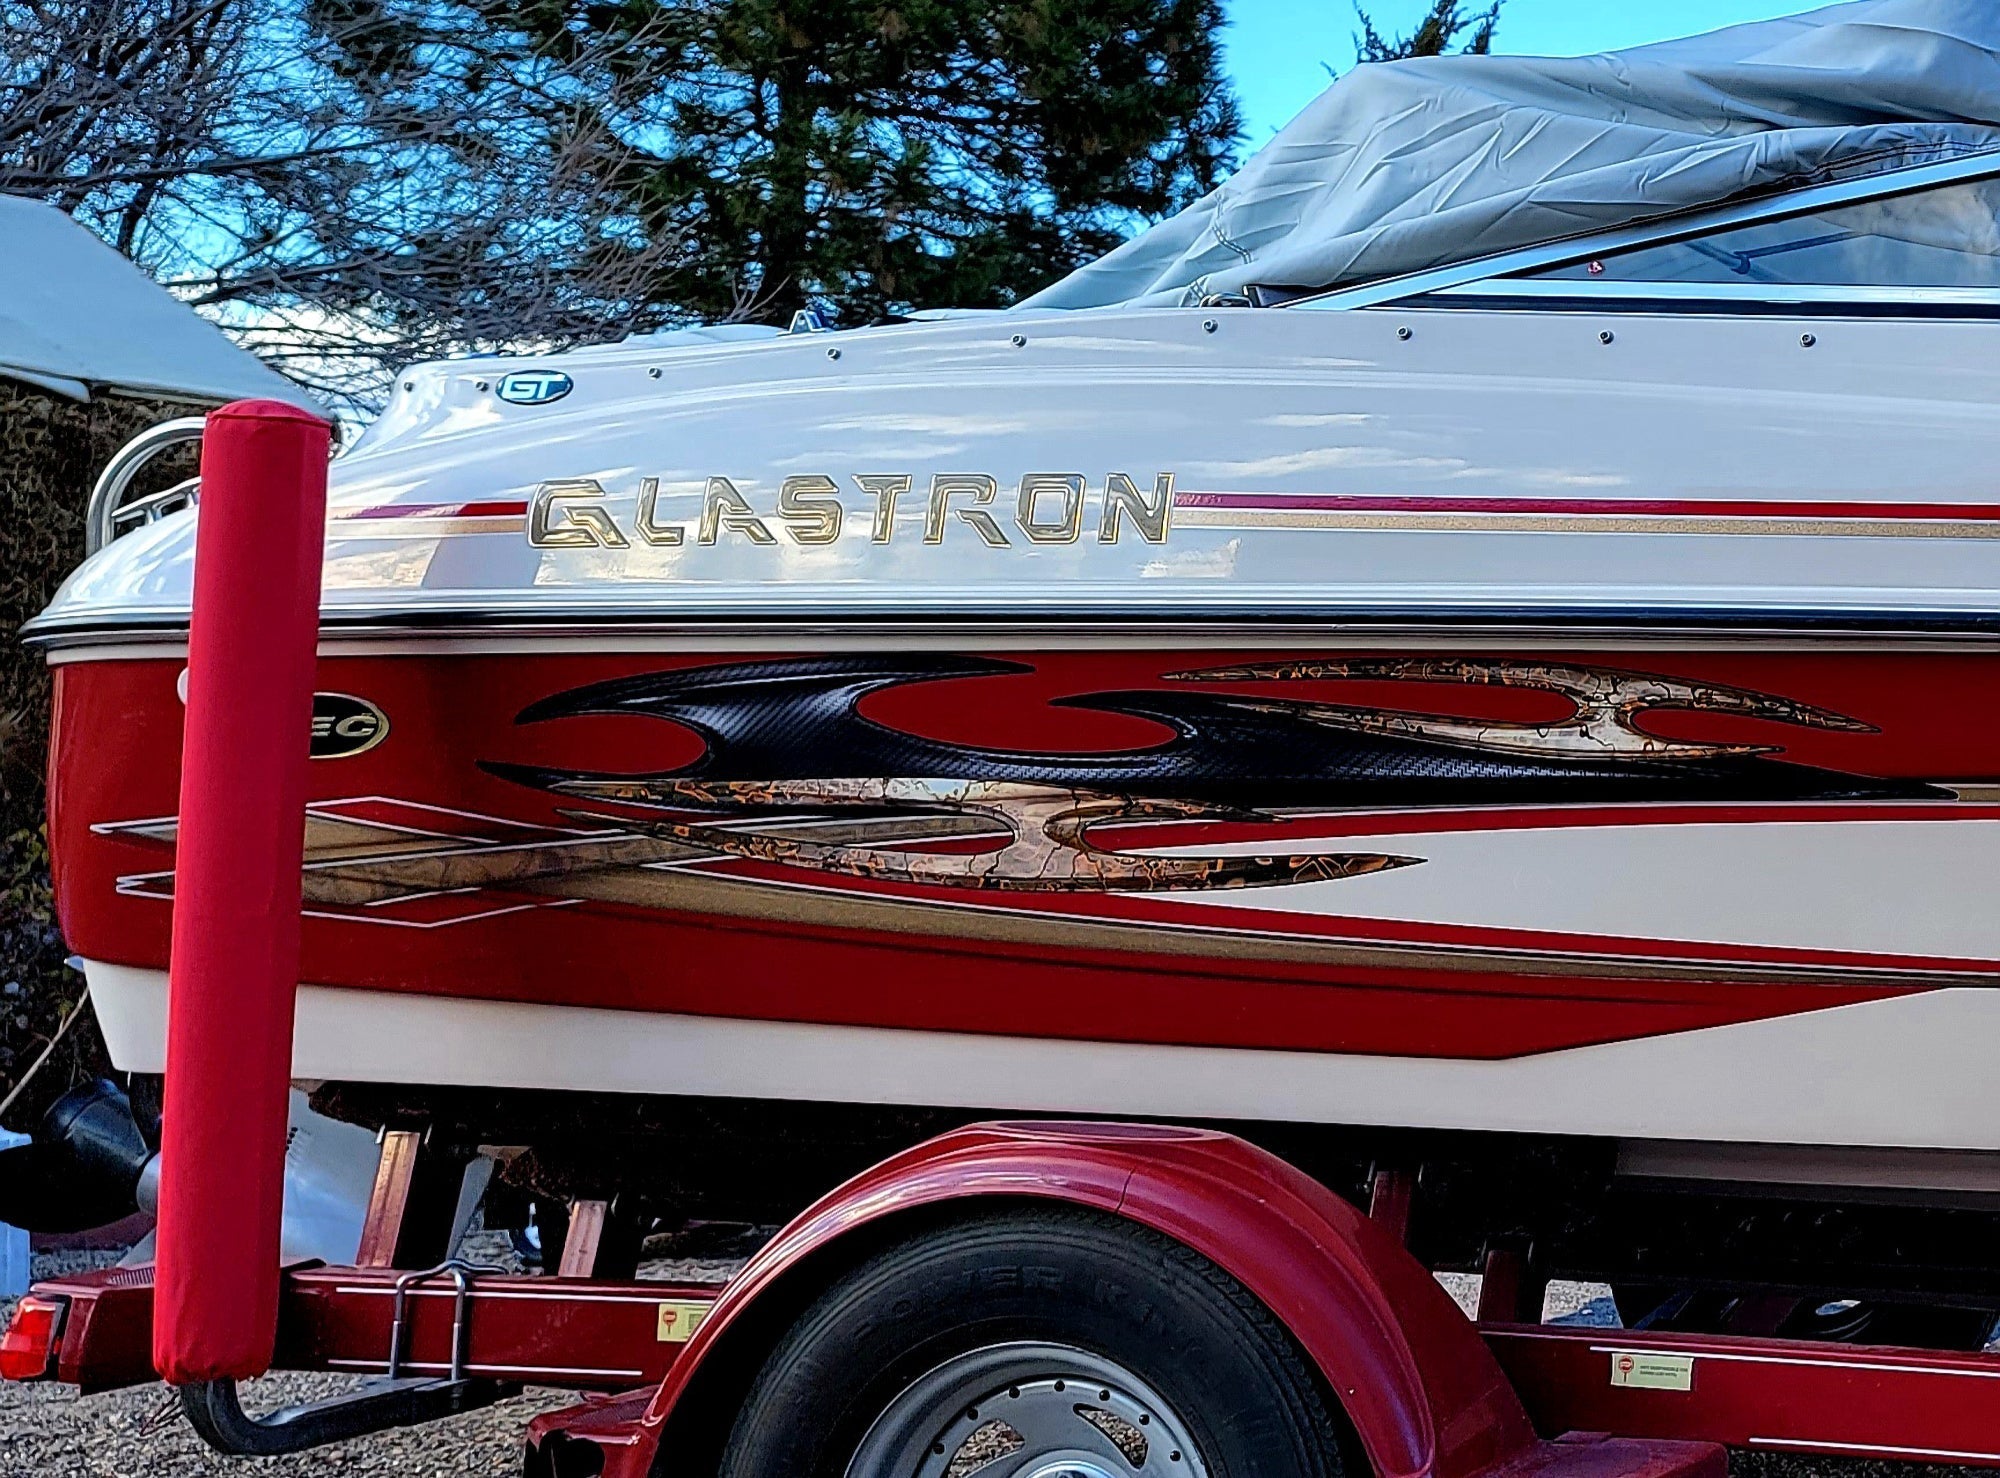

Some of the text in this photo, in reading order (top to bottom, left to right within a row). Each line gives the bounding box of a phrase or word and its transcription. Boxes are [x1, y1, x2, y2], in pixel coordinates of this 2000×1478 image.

[502, 374, 565, 399] GT
[528, 472, 1175, 548] GLASTRON
[311, 715, 378, 737] EC
